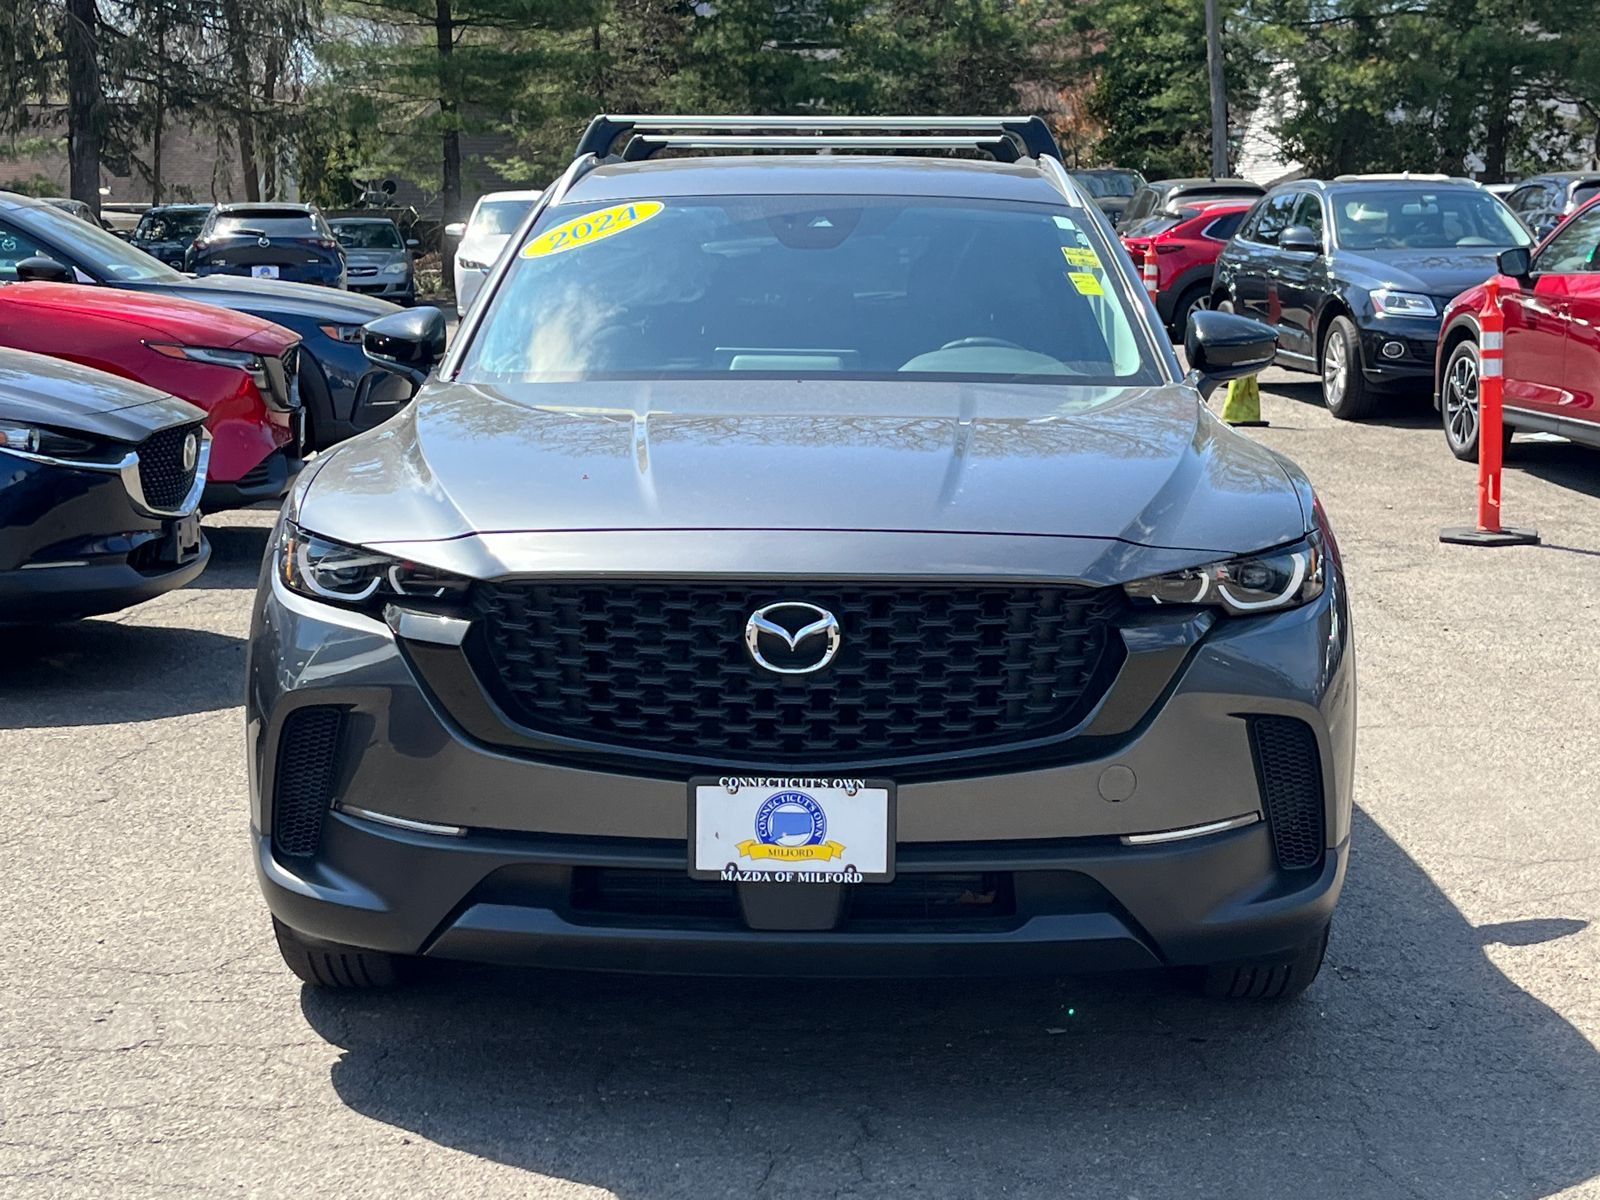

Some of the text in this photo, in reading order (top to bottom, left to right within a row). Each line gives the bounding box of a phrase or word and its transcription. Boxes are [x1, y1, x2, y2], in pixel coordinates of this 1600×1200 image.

[549, 205, 640, 250] 2024
[718, 776, 866, 789] CONNECTICUT'S OWN
[759, 794, 824, 838] CONNECTICUT'S OWN
[768, 848, 814, 857] MILFORD
[720, 870, 863, 884] MAZDA OF MILFORD
